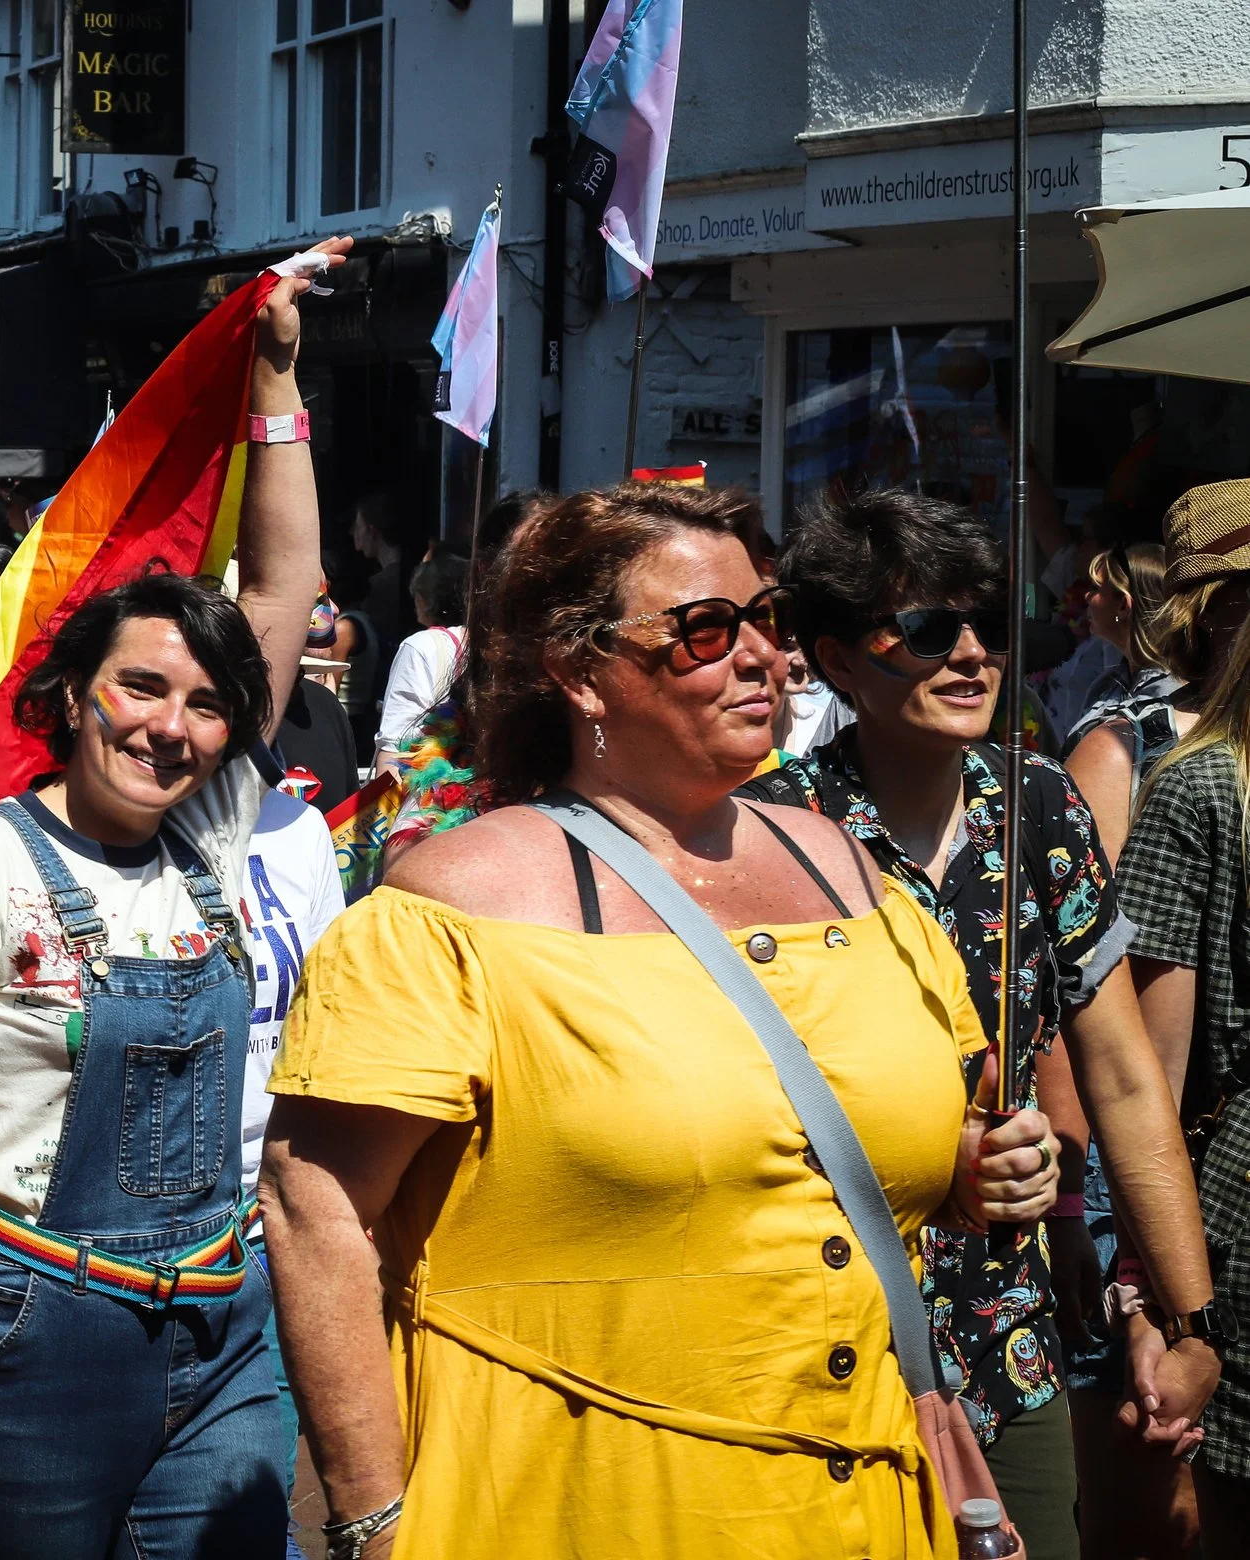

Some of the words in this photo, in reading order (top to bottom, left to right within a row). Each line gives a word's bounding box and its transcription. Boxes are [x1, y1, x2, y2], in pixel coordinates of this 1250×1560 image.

[77, 51, 170, 76] MAGIC
[93, 90, 152, 114] BAR
[821, 156, 1080, 208] www.thechildrenstrustorg.uk
[332, 808, 383, 848] ESTGATE
[335, 816, 389, 873] ONE
